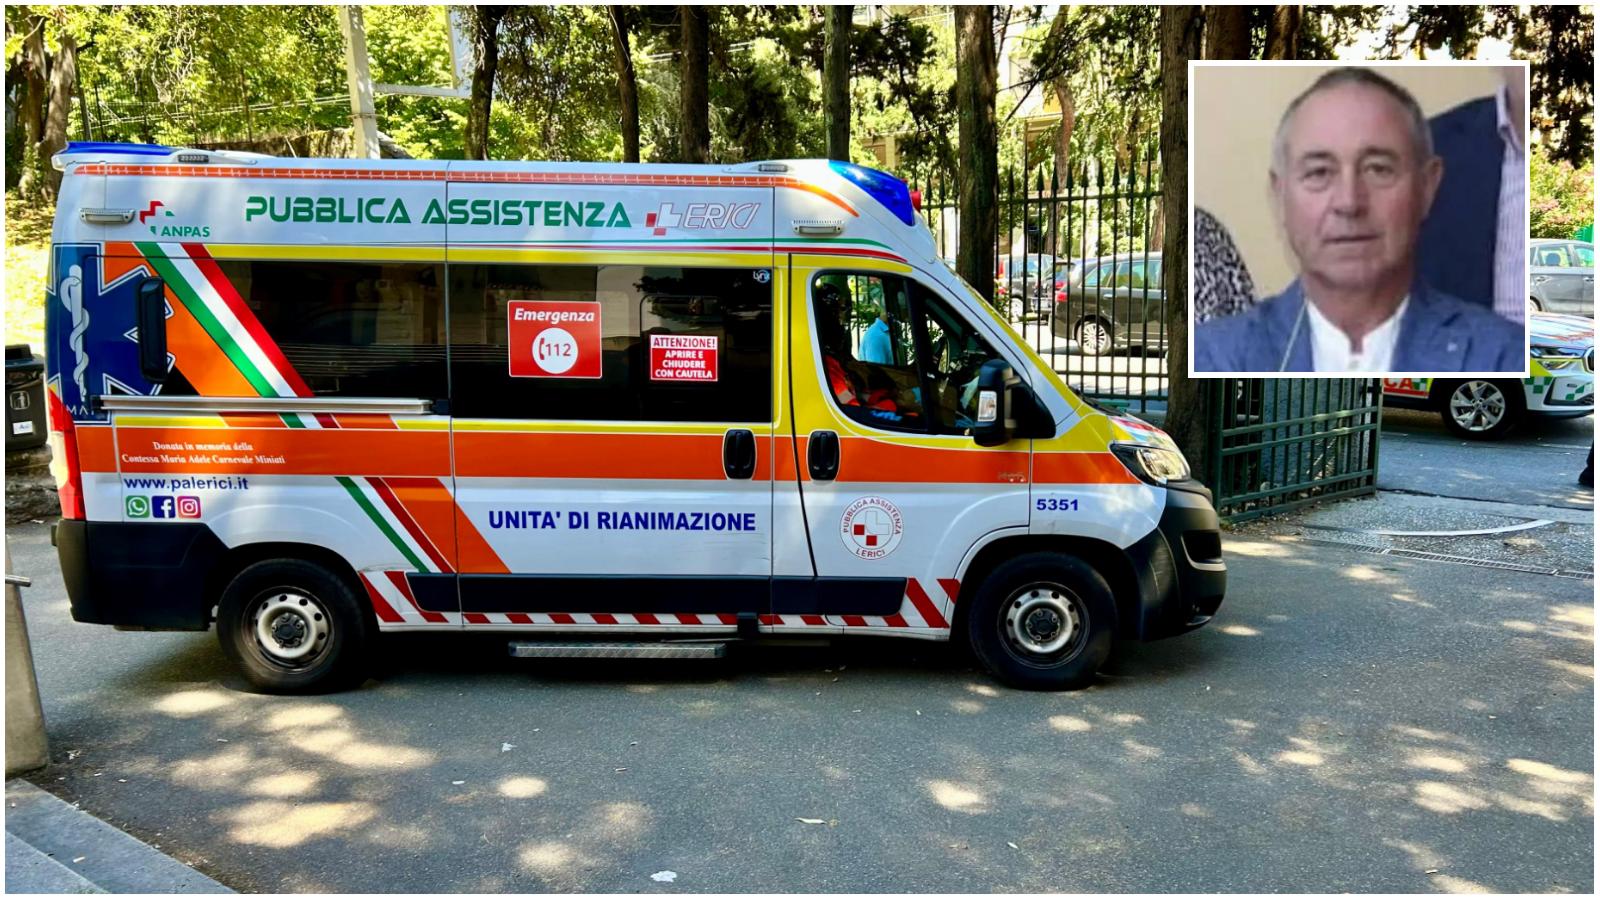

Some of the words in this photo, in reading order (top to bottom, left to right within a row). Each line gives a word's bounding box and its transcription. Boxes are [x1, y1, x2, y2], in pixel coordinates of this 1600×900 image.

[245, 196, 411, 224] PUBBLICA
[421, 198, 632, 228] ASSISTENZA
[160, 225, 210, 238] ANPAS
[514, 308, 595, 325] Emergenza
[653, 337, 716, 348] ATTENZIONE!
[545, 343, 572, 357] 112
[665, 349, 697, 359] APRIRE
[699, 350, 704, 359] E
[662, 359, 706, 369] CHIUDERE
[655, 369, 674, 378] CON
[676, 369, 713, 379] CAUTELA
[152, 441, 184, 451] Donata
[185, 442, 192, 451] in
[195, 442, 231, 451] memoria
[233, 441, 254, 451] della
[121, 454, 159, 463] Contessa
[160, 455, 186, 464] Maria
[188, 455, 210, 464] Adele
[212, 455, 253, 464] Carnevale
[255, 455, 286, 464] Miniati
[124, 477, 249, 492] www.palerici.it
[1036, 498, 1079, 511] 5351
[488, 510, 561, 529] UNITA'
[568, 511, 589, 530] DI
[597, 511, 756, 532] RIANIMAZIONE
[843, 499, 868, 533] PUBBLICA
[869, 498, 902, 535] ASSISTENZA
[856, 548, 885, 558] LERICI
